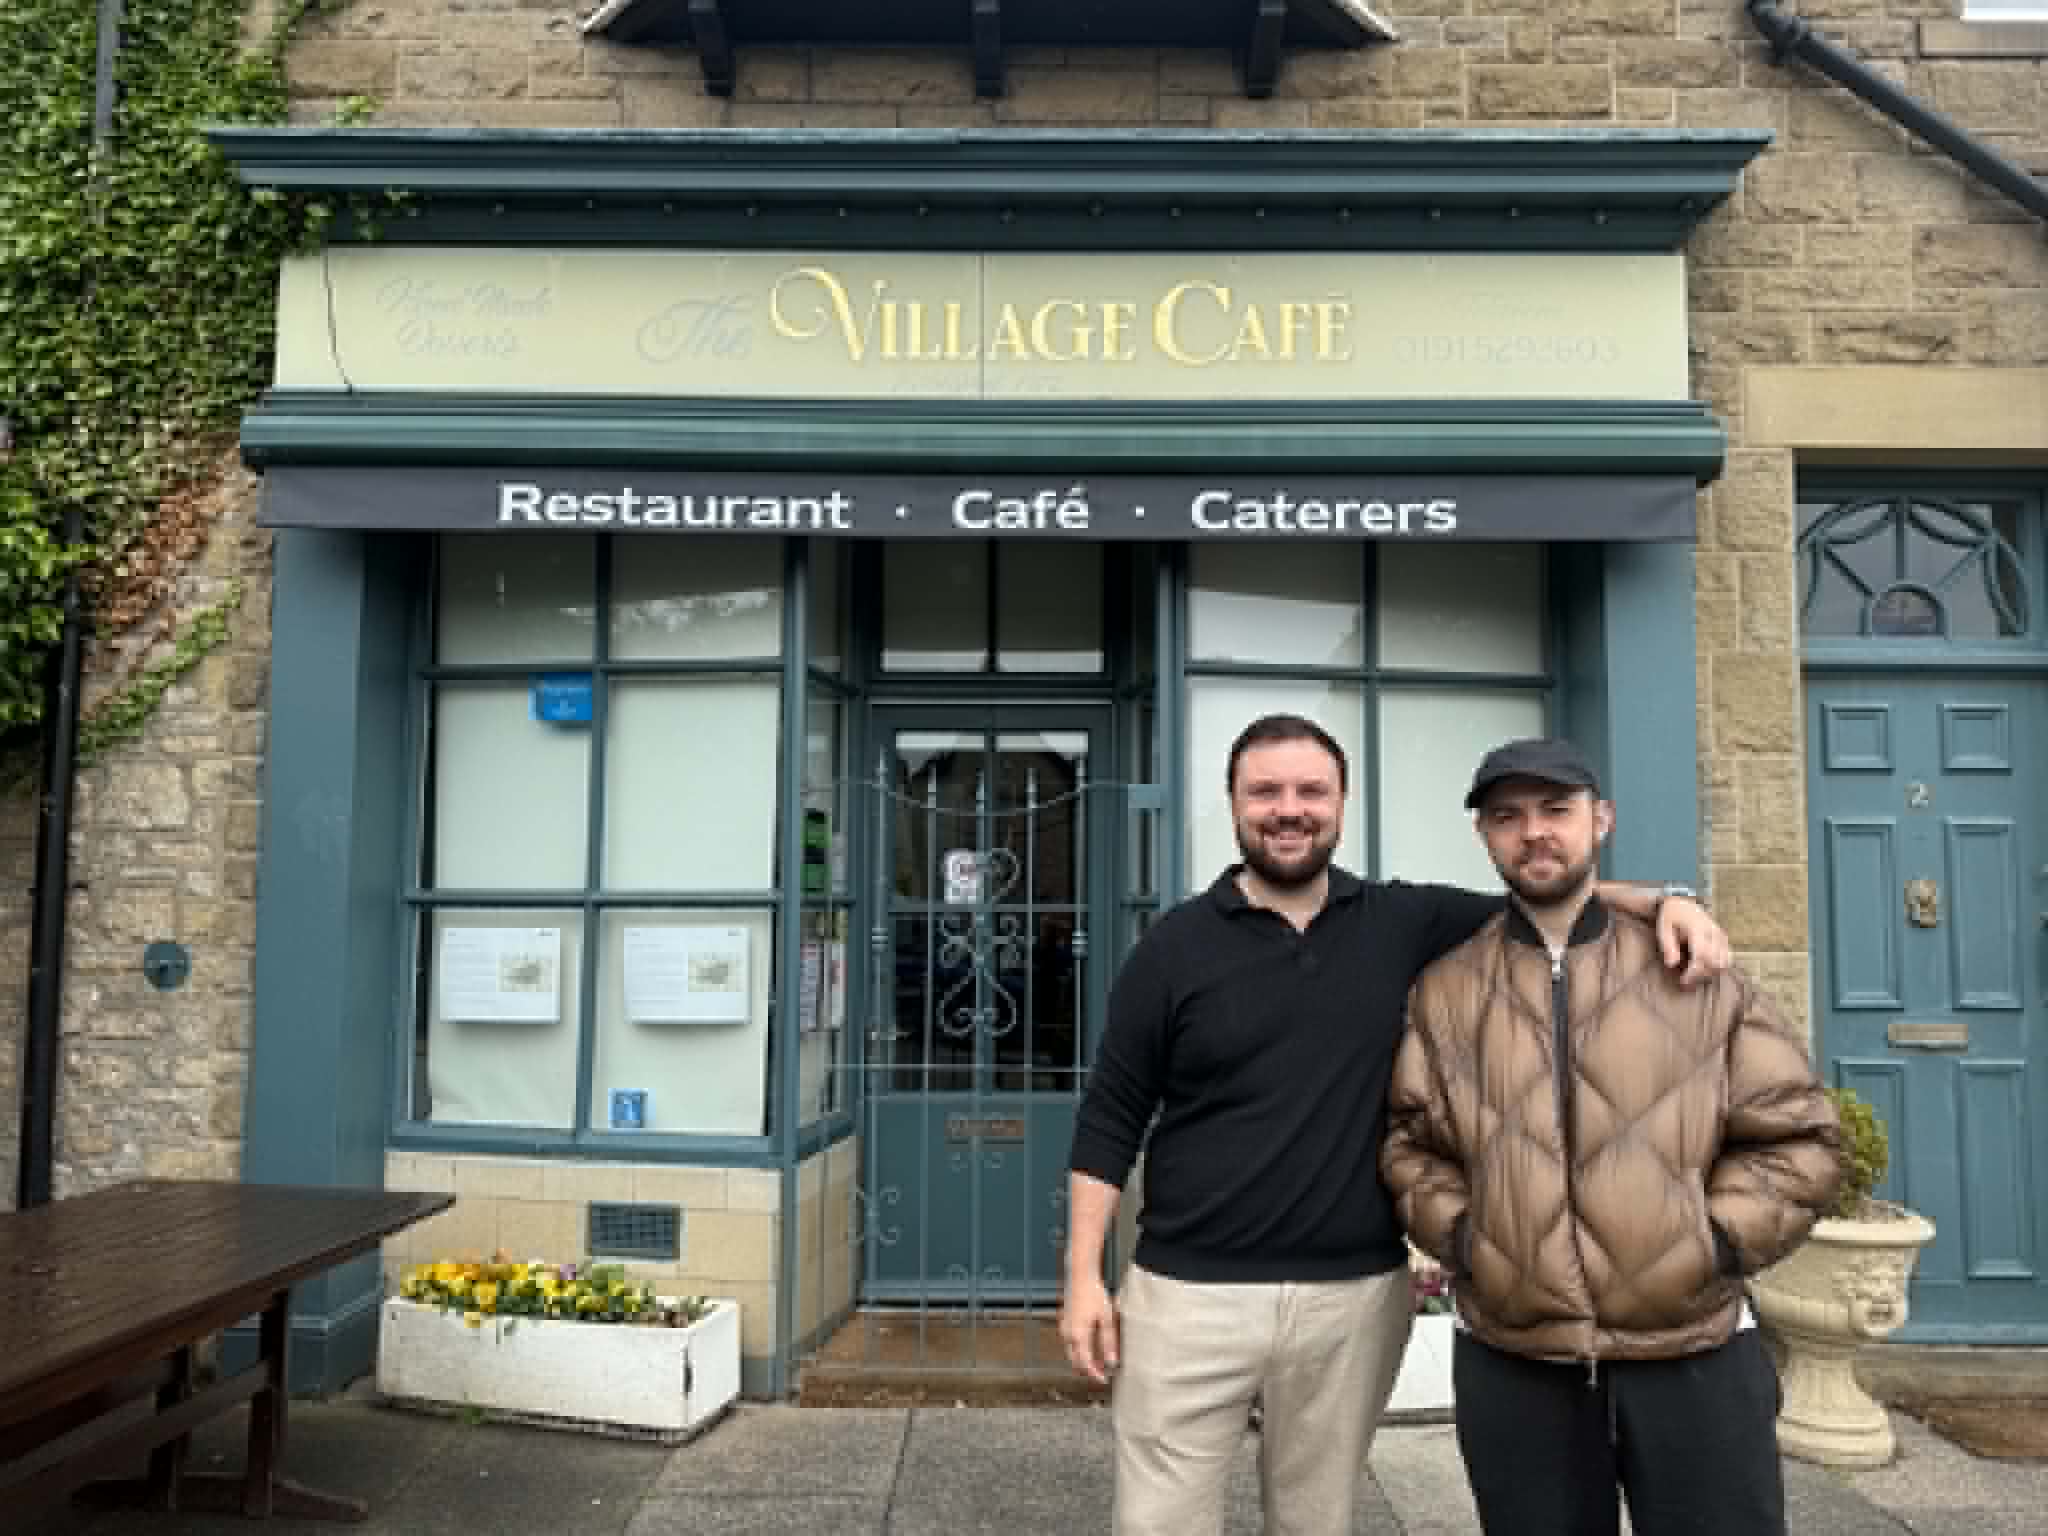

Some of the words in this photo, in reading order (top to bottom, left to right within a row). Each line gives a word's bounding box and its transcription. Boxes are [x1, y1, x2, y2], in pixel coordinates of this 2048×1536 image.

[635, 293, 757, 363] The
[498, 482, 852, 529] Restaurant
[951, 482, 1090, 531] Café
[1190, 489, 1458, 532] Caterers
